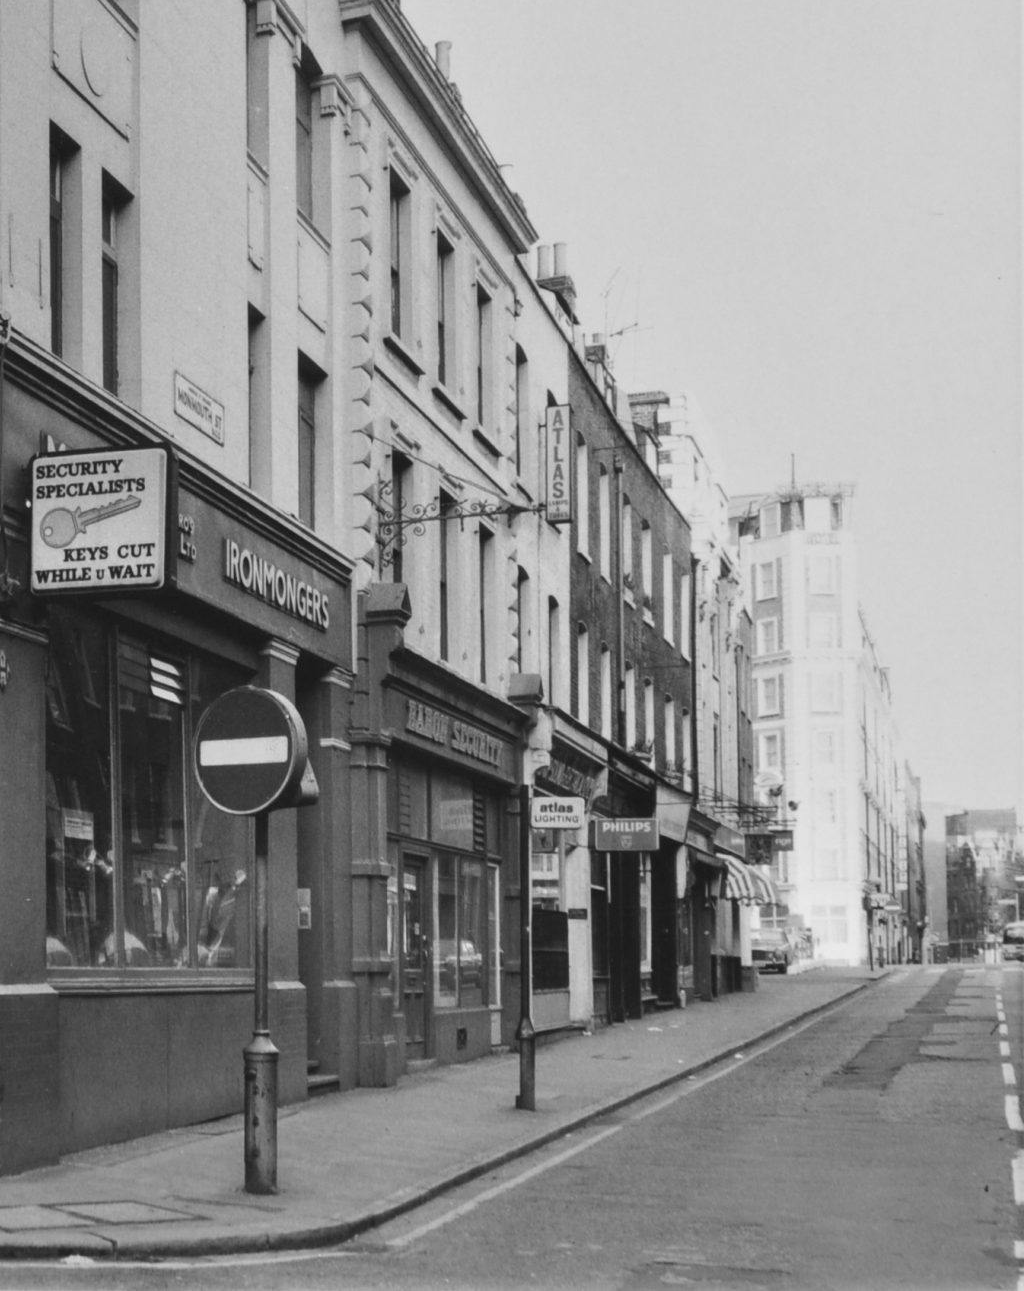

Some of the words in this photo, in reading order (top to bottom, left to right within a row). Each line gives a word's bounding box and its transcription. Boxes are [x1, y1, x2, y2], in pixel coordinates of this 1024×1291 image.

[552, 409, 564, 499] ATLAS
[36, 459, 123, 479] SECURITY
[36, 478, 145, 499] SPECIALISTS
[63, 546, 108, 562] KEYS
[117, 543, 155, 559] CUT
[35, 567, 91, 584] WHILE
[108, 563, 155, 579] WAIT
[225, 538, 331, 629] IRONMONGERS
[451, 720, 503, 767] SECURITY
[540, 801, 574, 813] atlas
[534, 815, 579, 823] LIGHTING
[602, 821, 652, 833] PHILIPS
